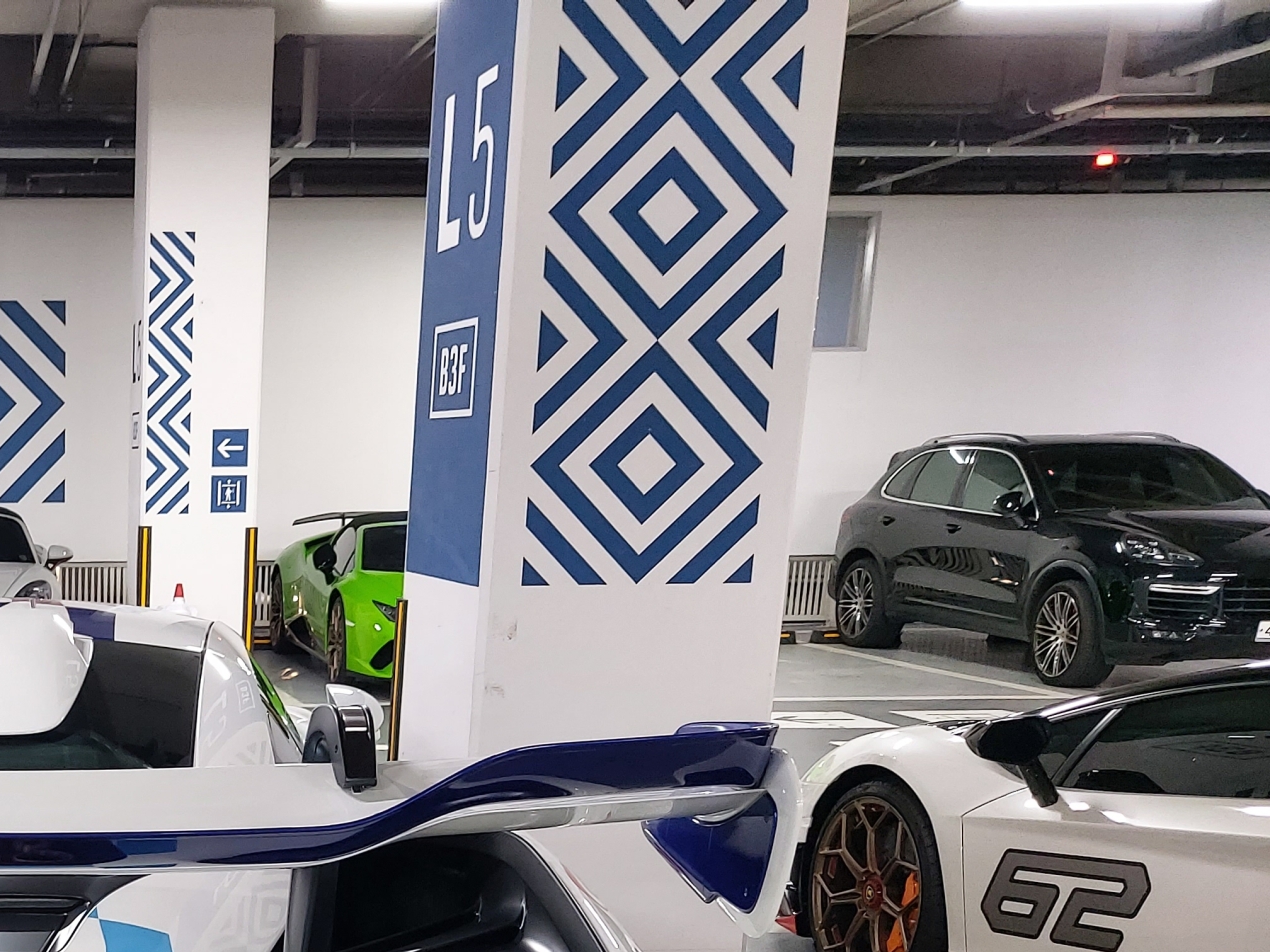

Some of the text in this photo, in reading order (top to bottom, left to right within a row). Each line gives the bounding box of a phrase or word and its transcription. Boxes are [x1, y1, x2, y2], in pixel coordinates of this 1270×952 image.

[437, 64, 499, 253] L5
[438, 343, 469, 397] B3F
[980, 848, 1151, 952] 62
